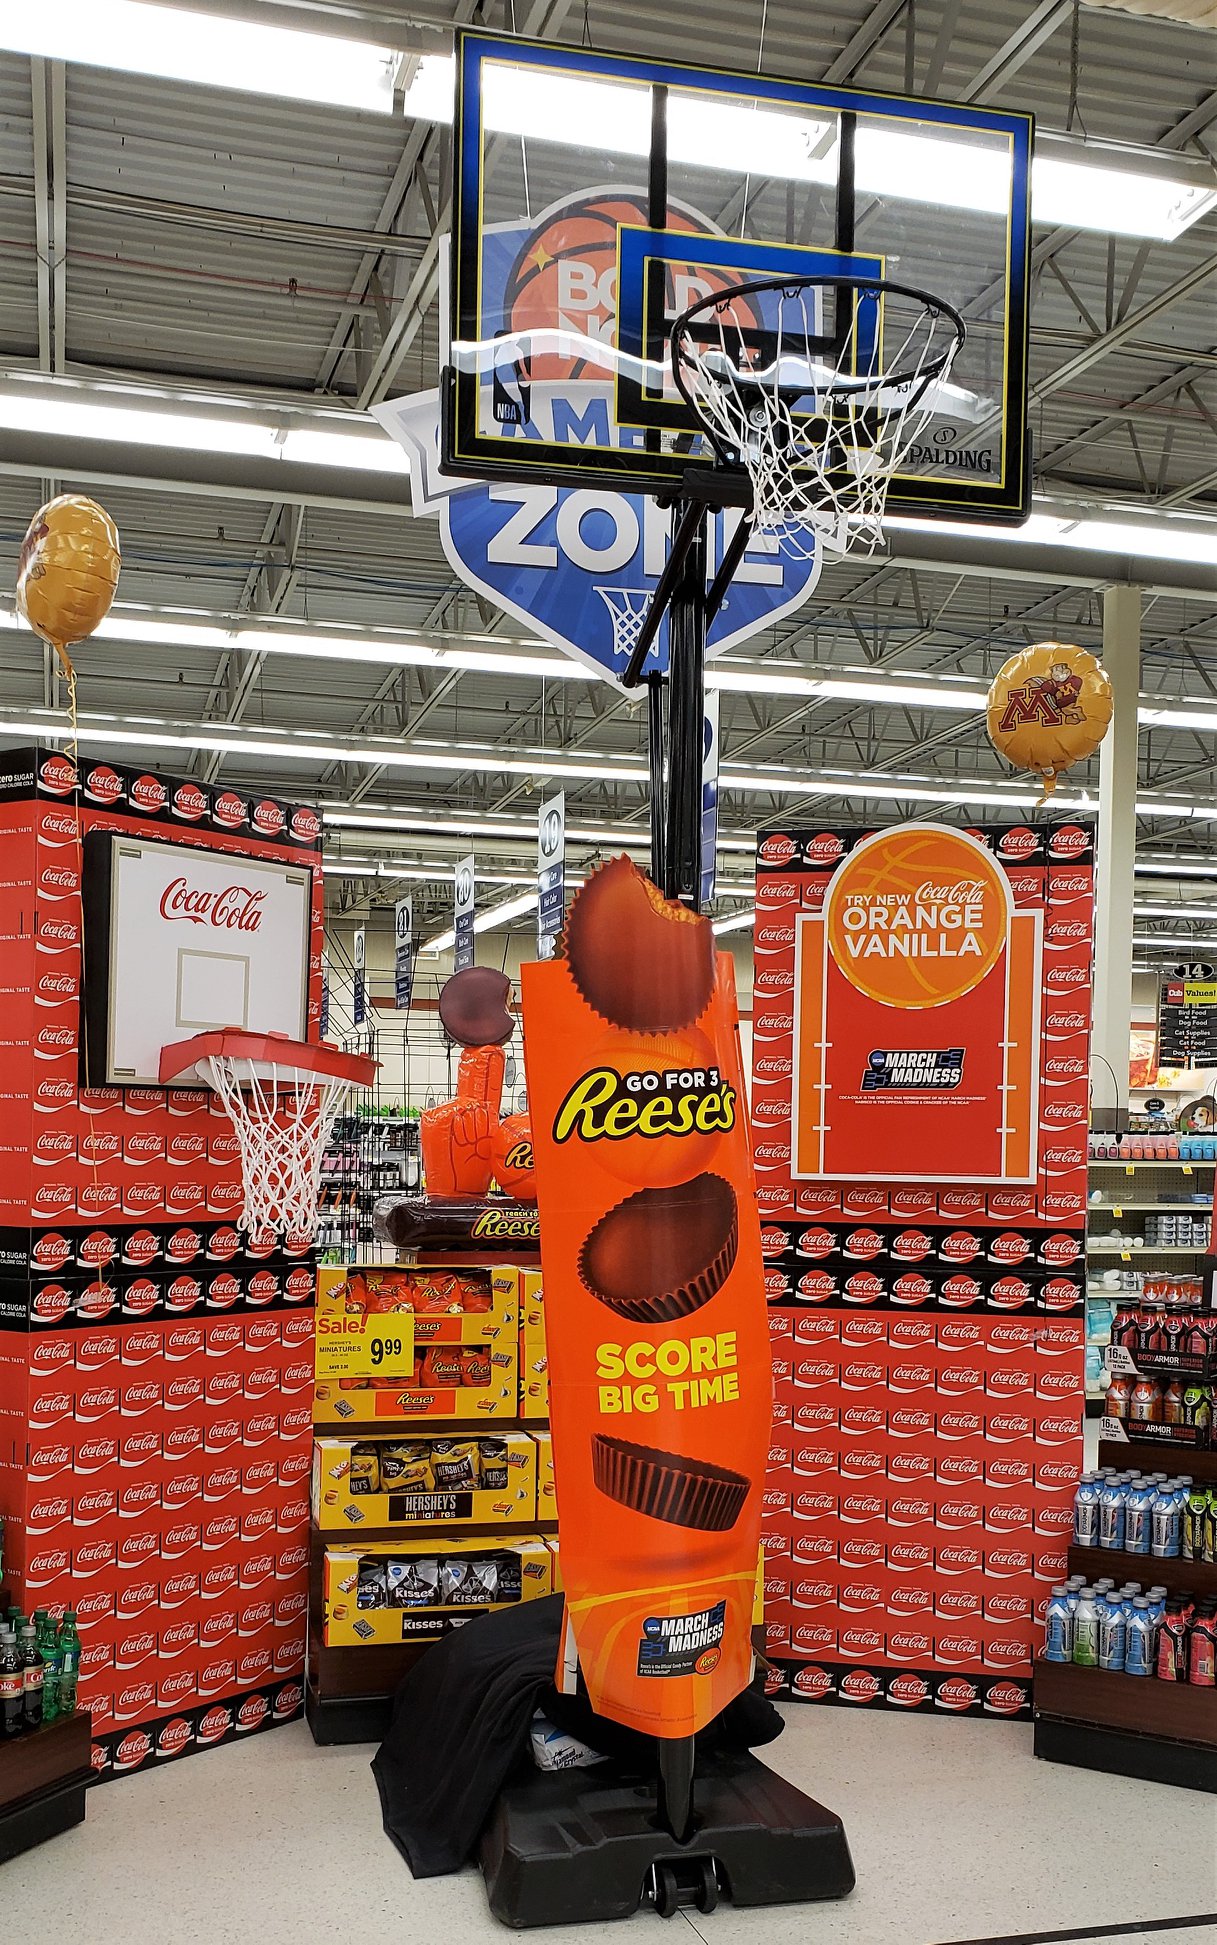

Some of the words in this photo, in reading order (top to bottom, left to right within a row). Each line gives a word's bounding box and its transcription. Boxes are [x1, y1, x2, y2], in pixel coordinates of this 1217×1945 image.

[497, 401, 517, 421] NBA
[13, 772, 34, 781] SUGAR
[543, 812, 559, 855] 19
[845, 895, 873, 906] TRY
[876, 894, 912, 906] NEW
[914, 880, 989, 905] Coca-Cola
[160, 877, 269, 932] Coca-Cola
[842, 904, 984, 931] ORANGE
[844, 932, 983, 958] VANILLA
[1182, 964, 1204, 978] 14
[1186, 989, 1216, 997] Values!
[885, 1053, 937, 1068] MARCH
[1187, 1049, 1211, 1057] Supplies
[626, 1074, 659, 1091] GO
[666, 1071, 705, 1090] FOR
[709, 1071, 719, 1087] 3
[890, 1068, 961, 1083] MADNESS
[555, 1070, 735, 1141] Reese's
[6, 1251, 27, 1260] SUGAR
[6, 1304, 27, 1312] SUGAR
[318, 1313, 370, 1335] Sale!
[414, 1322, 441, 1331] eese's
[596, 1331, 737, 1380] SCORE
[1108, 1348, 1118, 1359] 16
[396, 1392, 435, 1405] Reese's
[598, 1384, 659, 1414] BIG
[666, 1372, 740, 1410] TIME
[1101, 1418, 1111, 1429] 16
[405, 1495, 457, 1512] HERSHEY'S
[405, 1511, 456, 1520] miniatures
[661, 1612, 709, 1637] MARCH
[668, 1622, 724, 1653] MADNESS
[0, 1682, 15, 1691] oke
